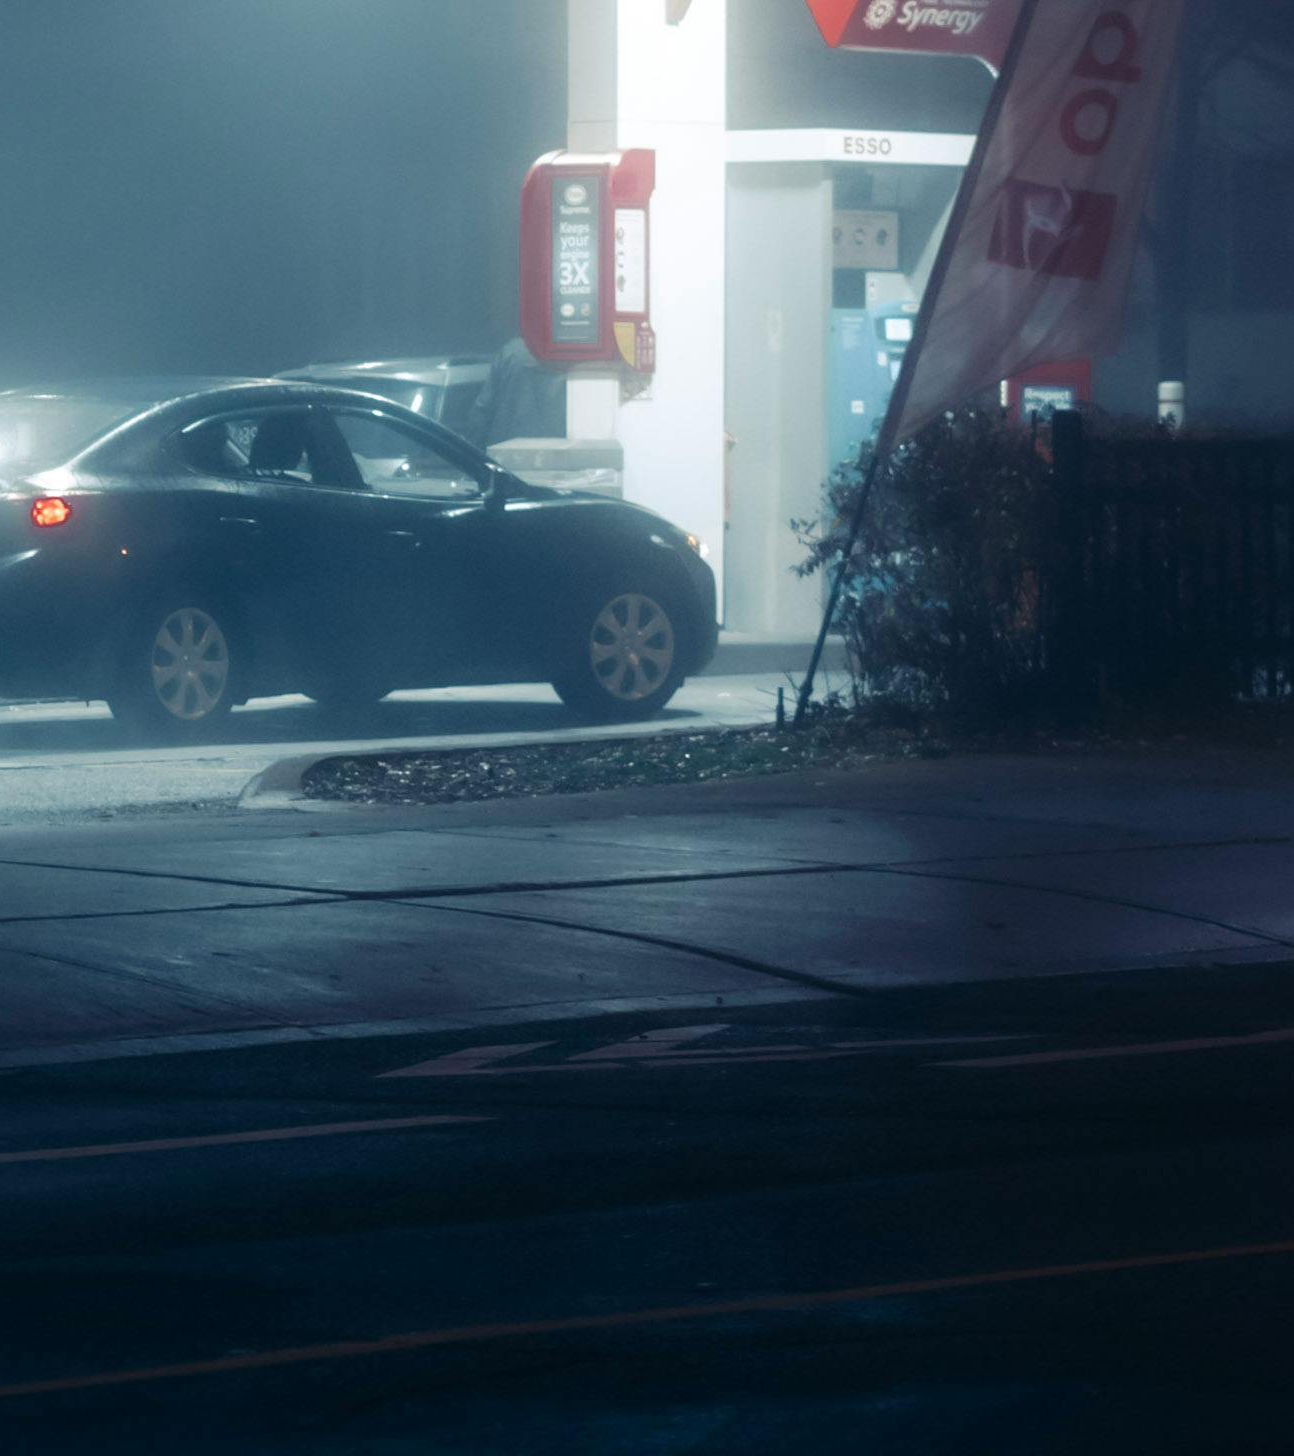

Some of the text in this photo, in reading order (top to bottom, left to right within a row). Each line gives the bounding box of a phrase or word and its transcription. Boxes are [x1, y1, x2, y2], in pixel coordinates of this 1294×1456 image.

[896, 0, 984, 35] Synergy
[843, 136, 892, 155] ESSO
[560, 222, 590, 235] Keeps
[560, 235, 589, 252] your
[559, 262, 590, 286] 3X
